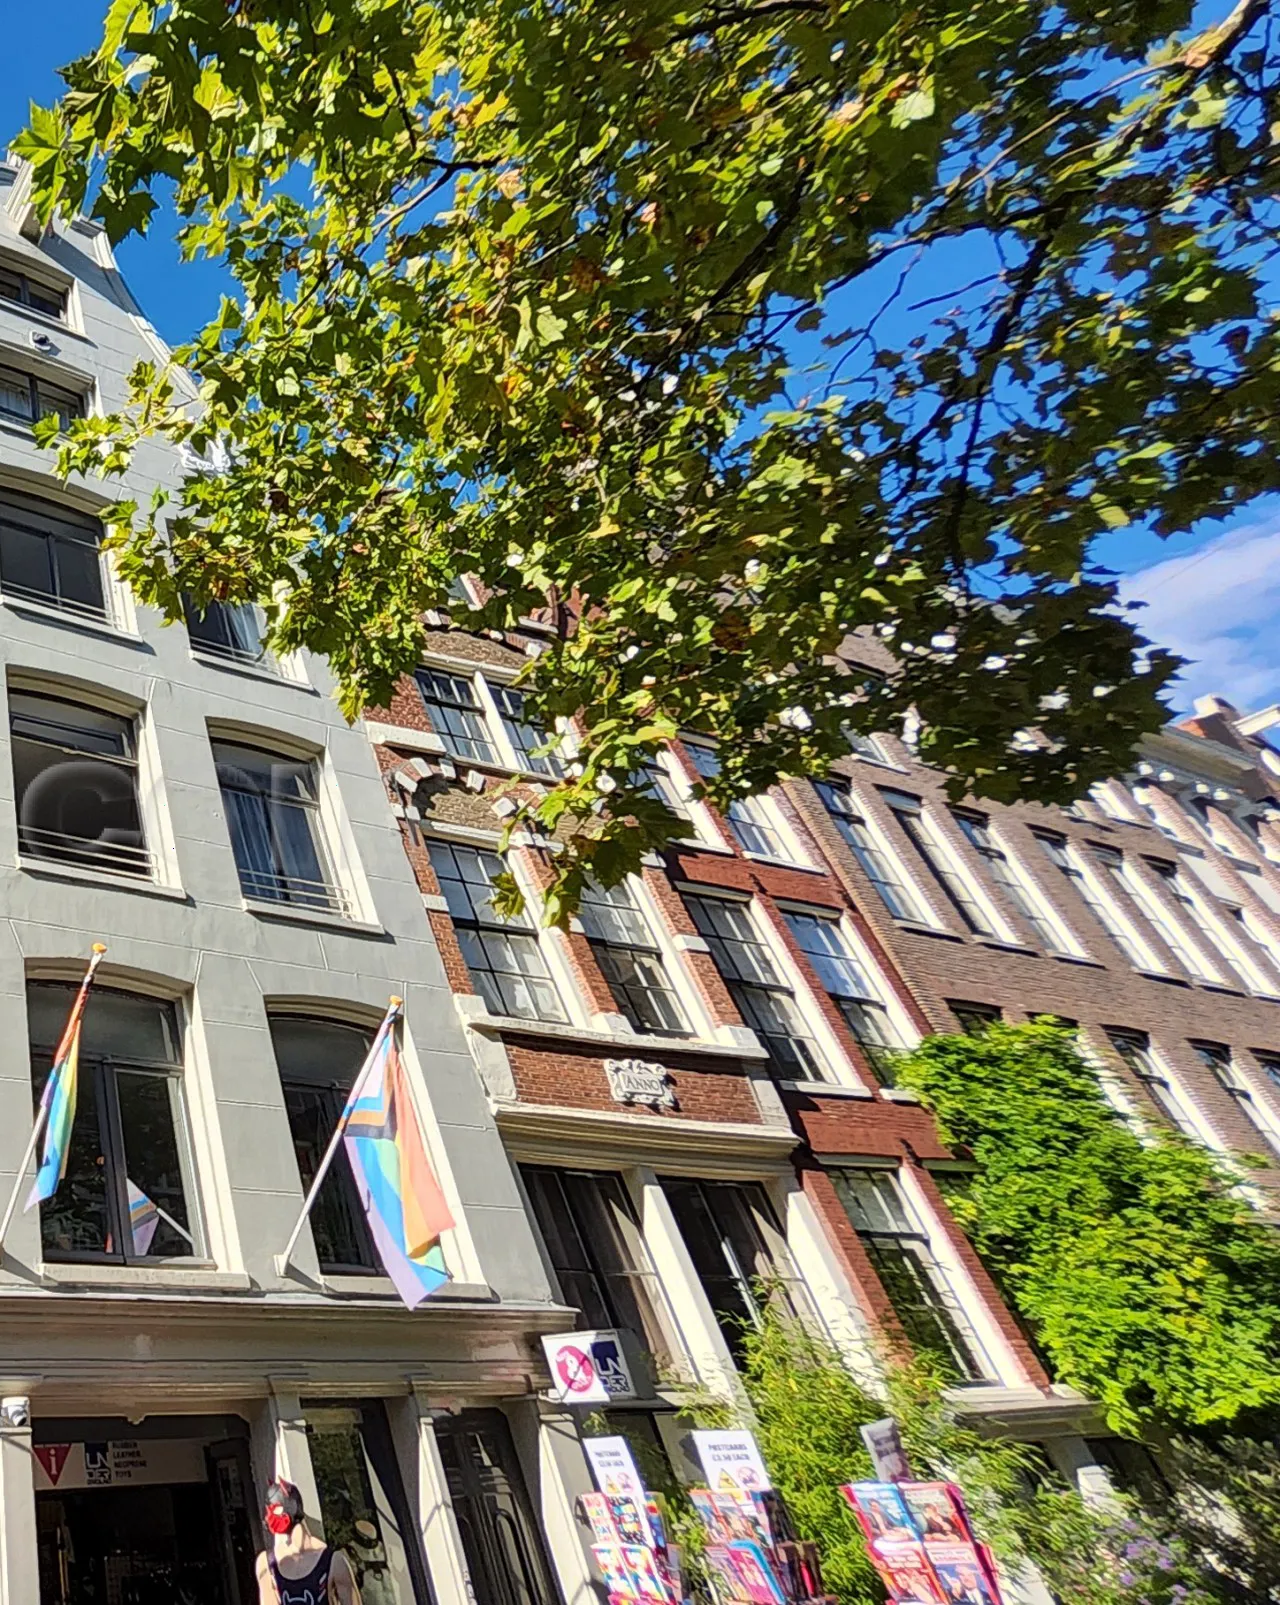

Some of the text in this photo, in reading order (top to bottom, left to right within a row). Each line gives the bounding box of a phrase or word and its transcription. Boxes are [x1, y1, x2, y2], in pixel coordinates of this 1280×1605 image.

[624, 1074, 660, 1091] ANNO
[113, 1450, 142, 1459] LEATHER
[115, 1470, 132, 1478] TOYS
